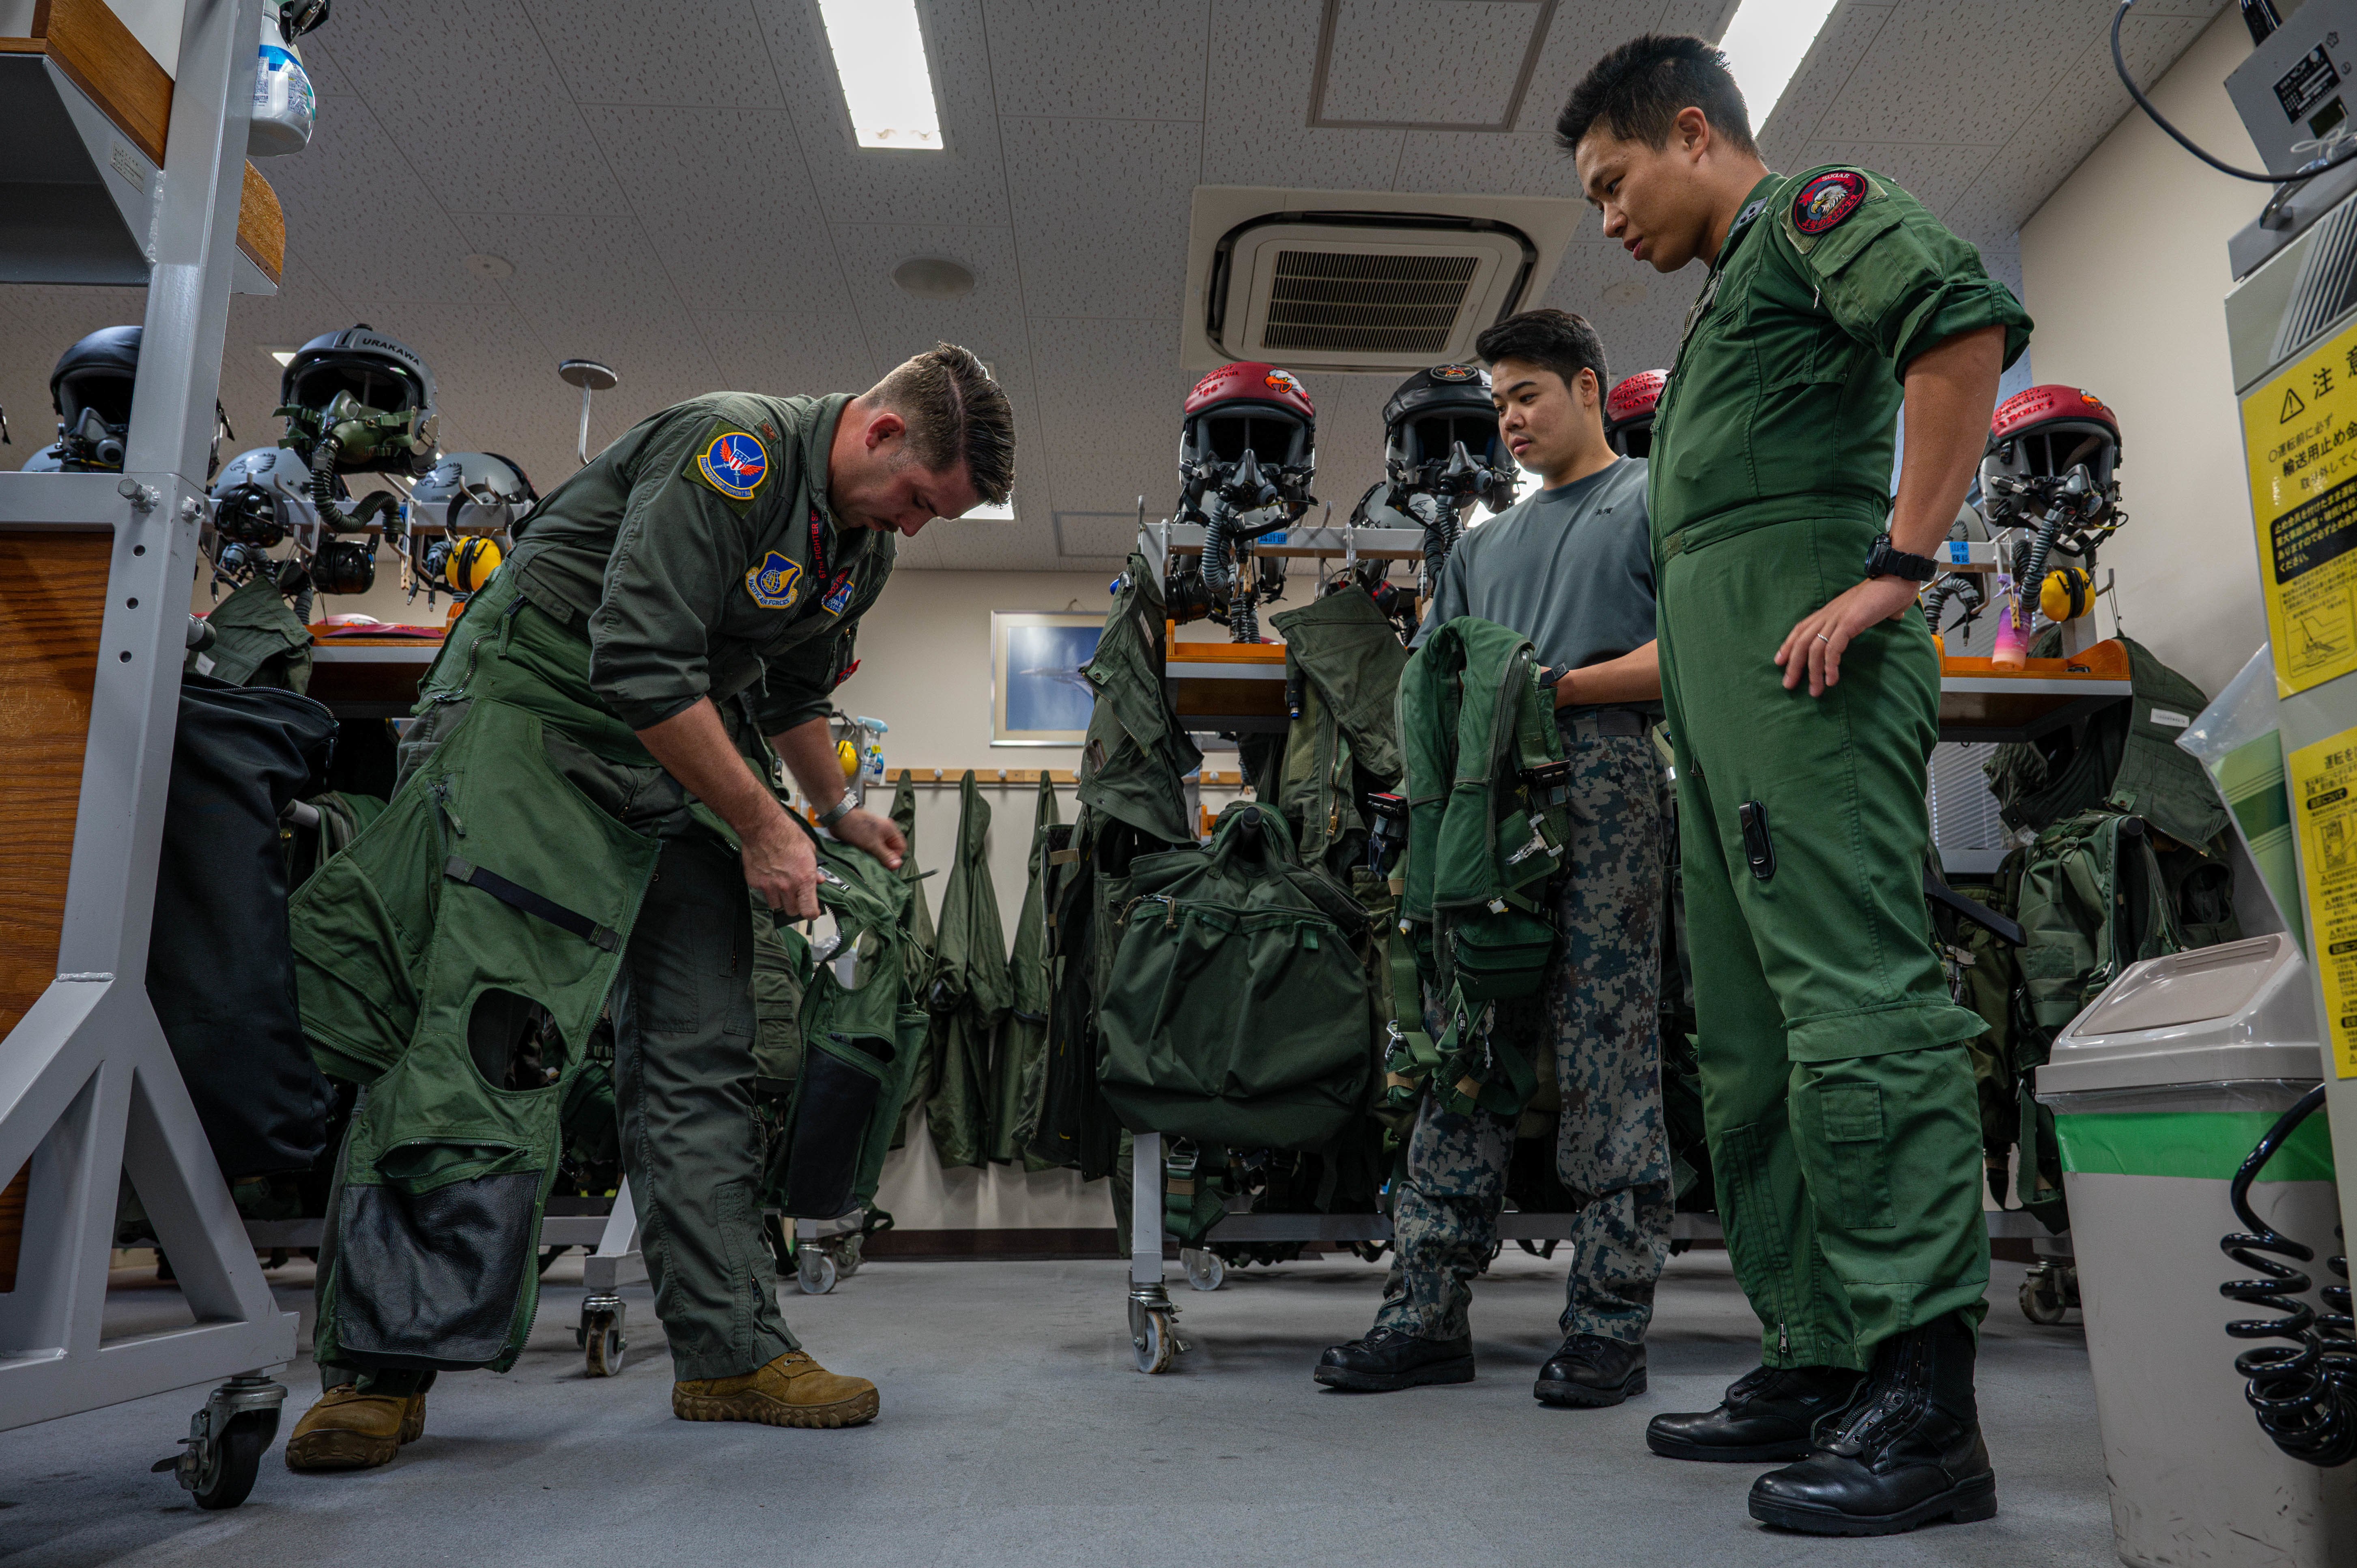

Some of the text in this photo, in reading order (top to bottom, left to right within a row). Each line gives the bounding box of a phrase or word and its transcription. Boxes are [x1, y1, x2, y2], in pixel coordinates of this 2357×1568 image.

[1822, 173, 1850, 181] SUGAR
[362, 338, 419, 365] URAKAWA
[1613, 382, 1664, 403] Squadro
[812, 523, 823, 560] FIGHTER
[748, 578, 762, 599] PACIFIC
